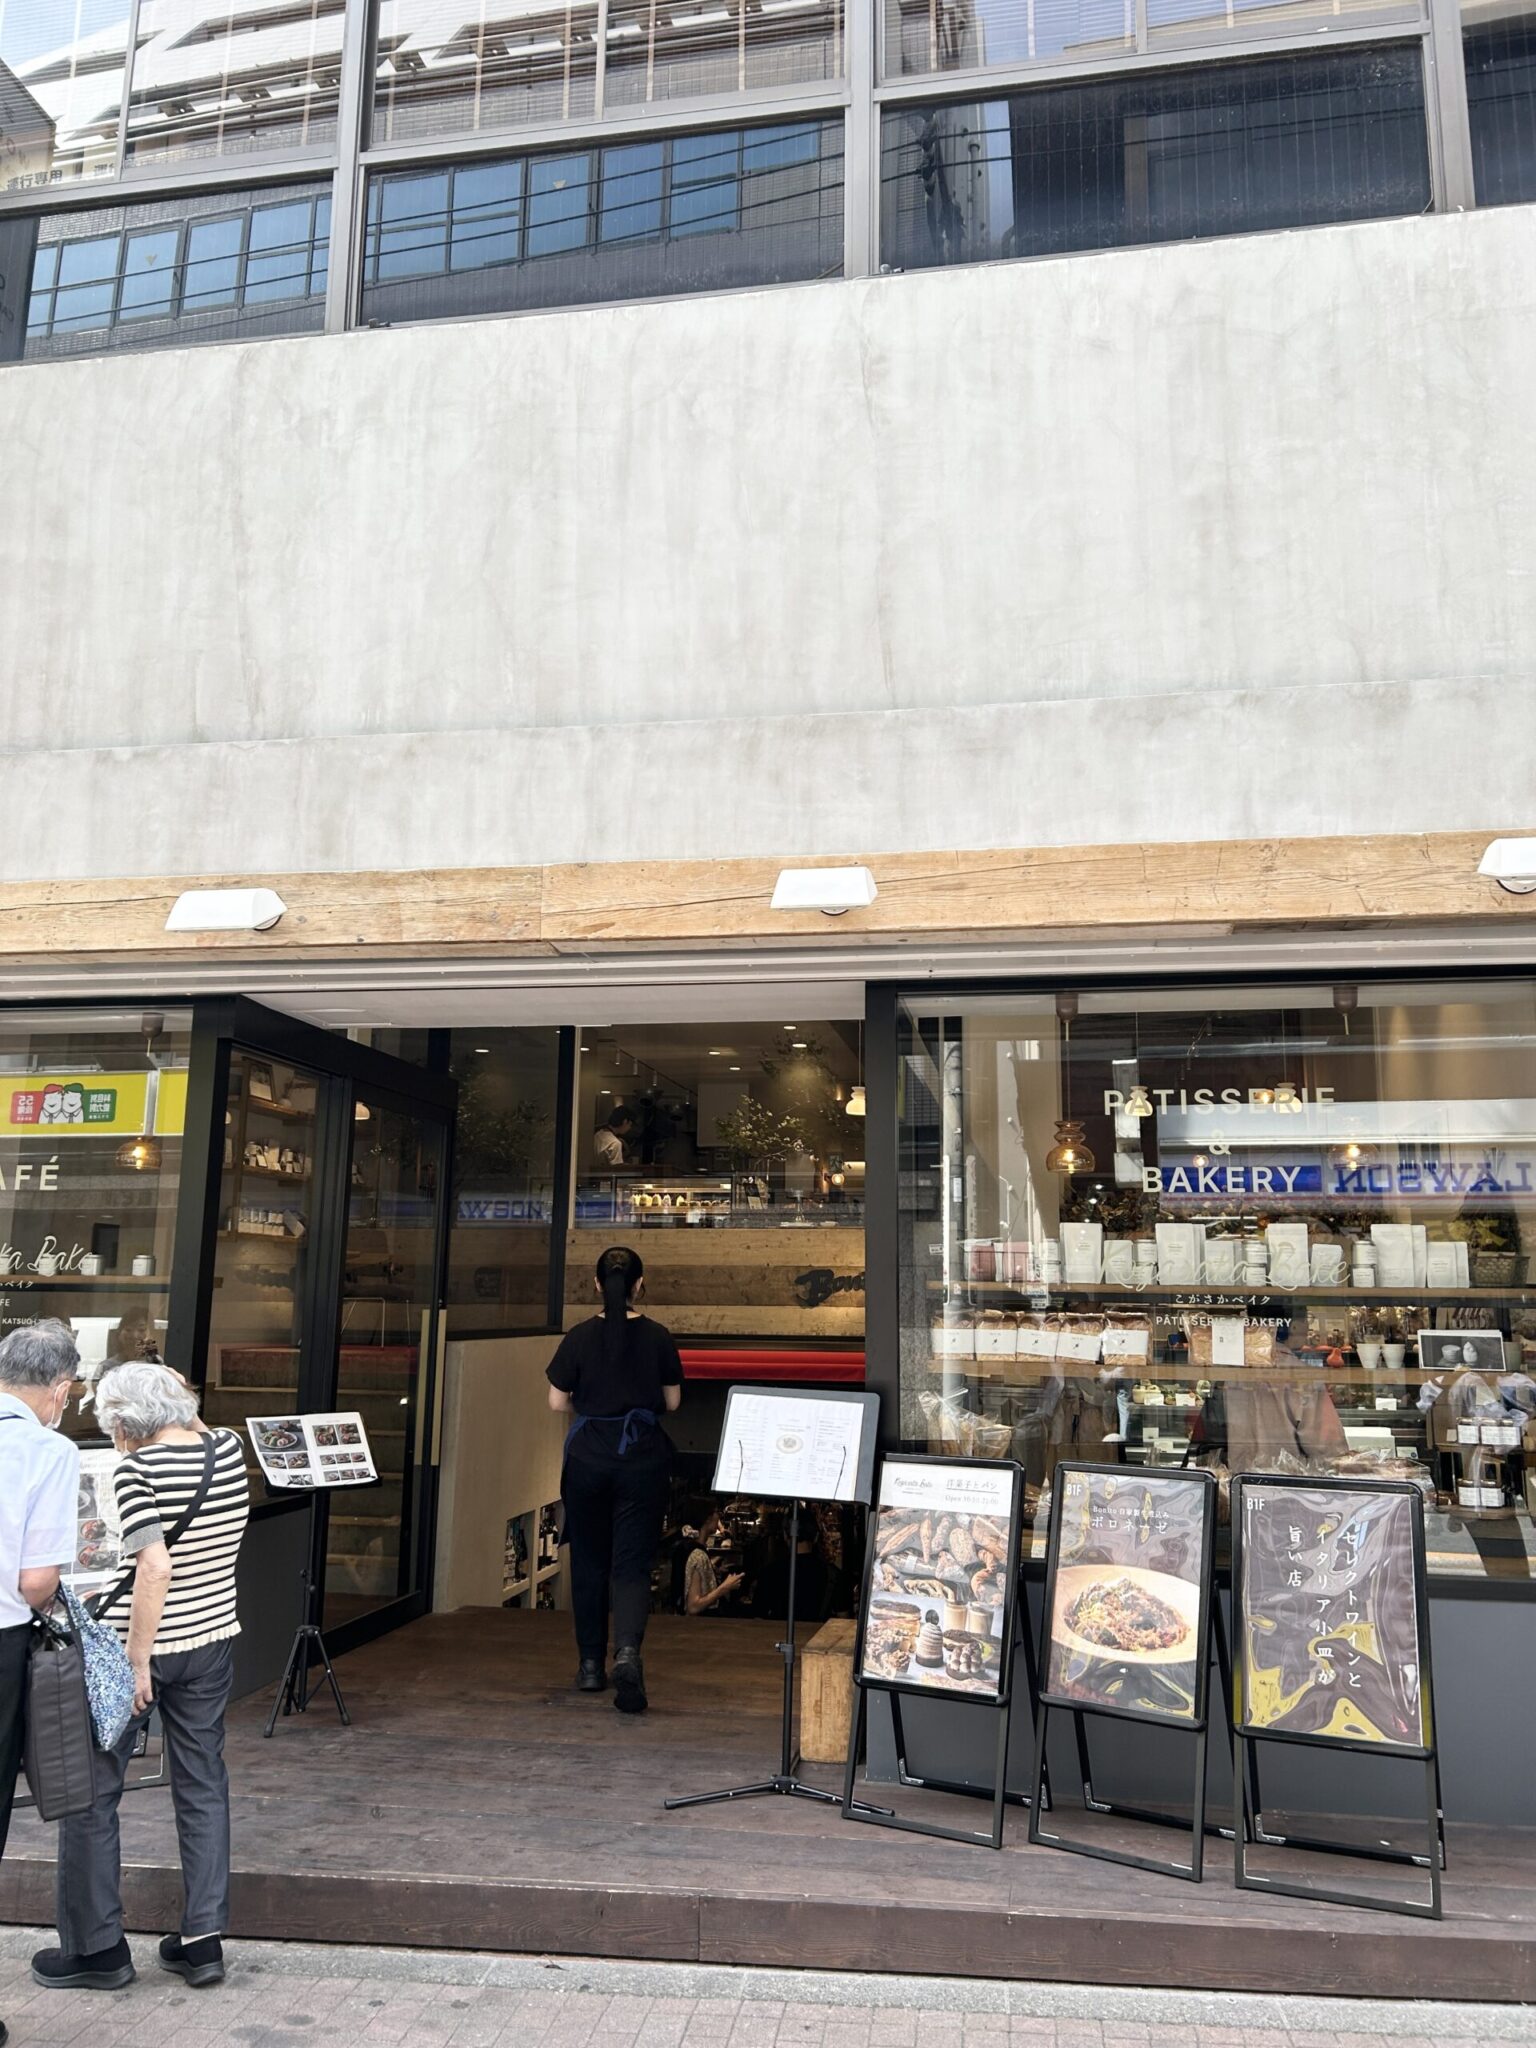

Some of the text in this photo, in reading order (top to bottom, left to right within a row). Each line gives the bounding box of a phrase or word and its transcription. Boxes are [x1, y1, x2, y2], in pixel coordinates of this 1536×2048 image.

[1208, 1129, 1232, 1155] &
[1142, 1166, 1301, 1193] BAKERY
[0, 1280, 34, 1289] ベイク
[1175, 1294, 1271, 1306] こがさかベイク
[1244, 1317, 1292, 1328] BAKERY
[1066, 1483, 1082, 1496] B1F
[1246, 1498, 1265, 1511] B1F
[1287, 1525, 1303, 1587] 旨い店
[1315, 1530, 1334, 1686] イタリア小皿が
[1341, 1531, 1362, 1688] セレクトワインと
